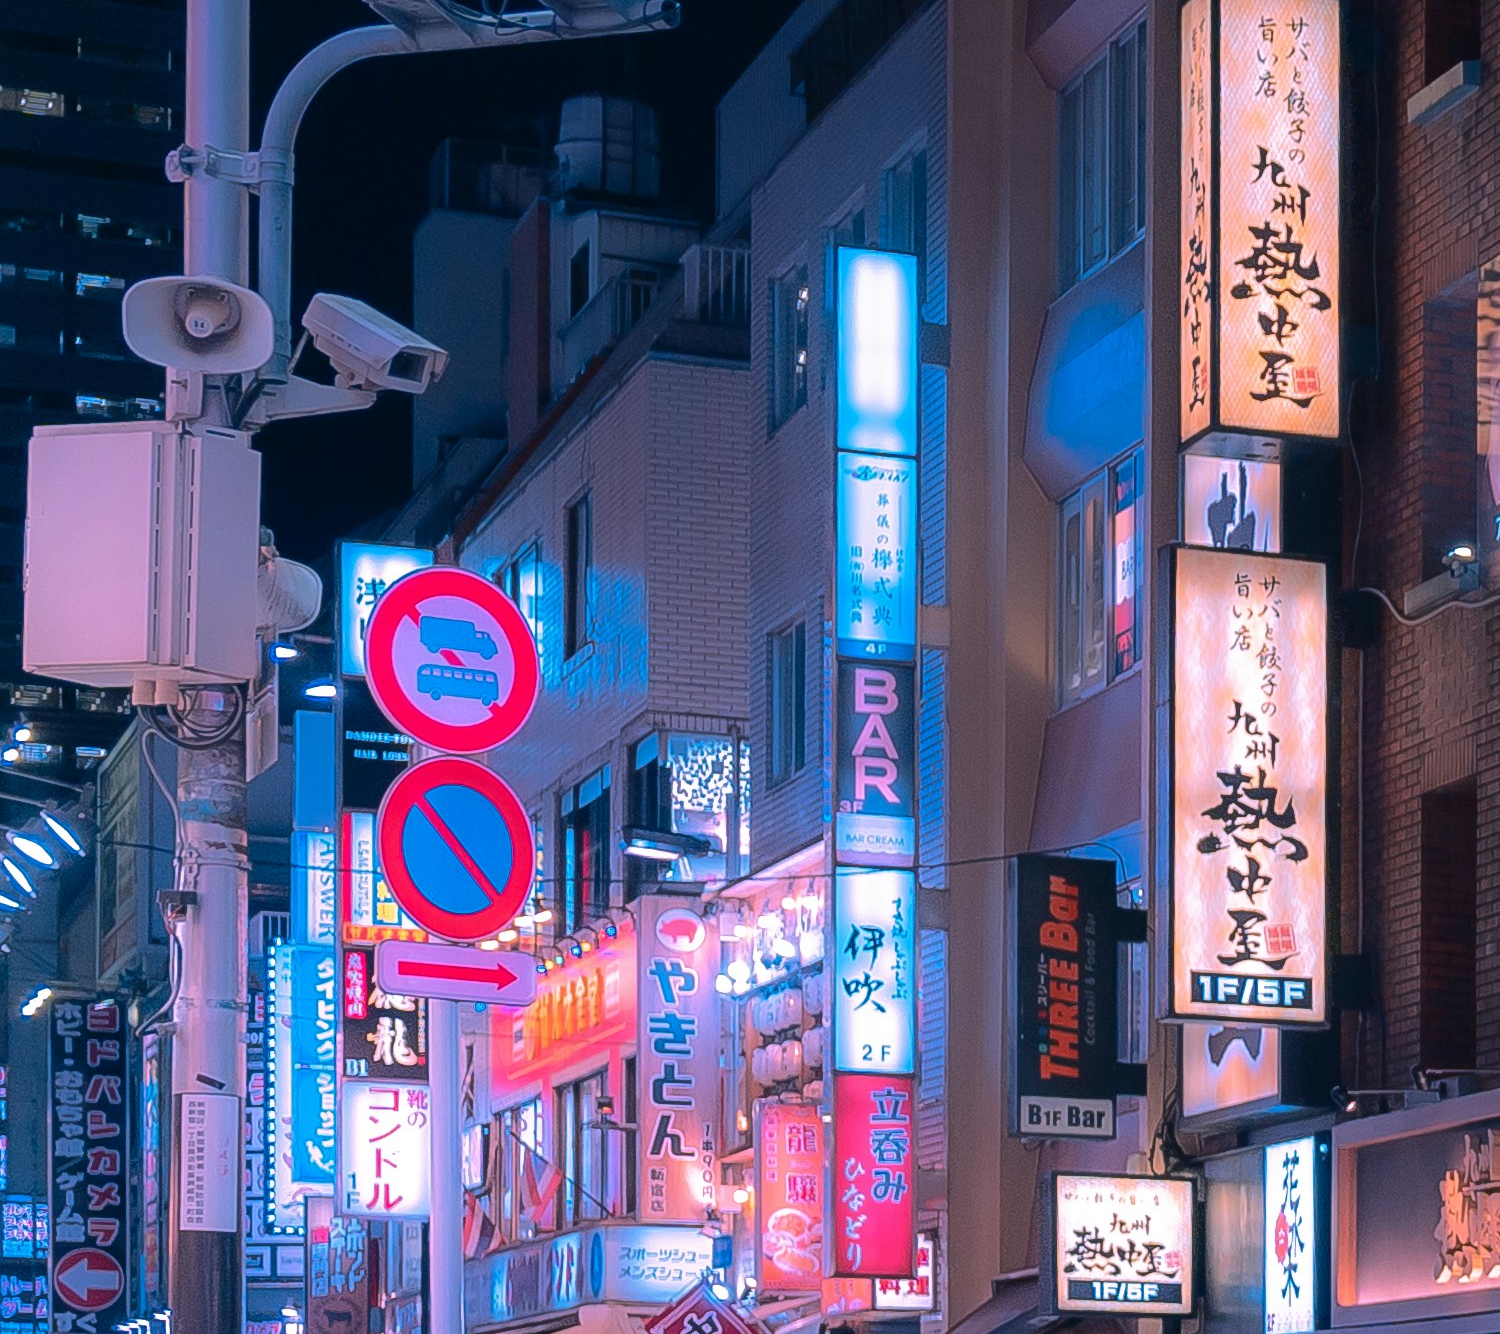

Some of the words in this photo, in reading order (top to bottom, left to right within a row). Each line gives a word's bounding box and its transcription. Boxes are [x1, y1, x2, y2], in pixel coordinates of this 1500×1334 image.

[1255, 16, 1279, 98] 旨い店
[1284, 16, 1311, 165] サバと餃子の
[1230, 145, 1332, 408] 九州熱中屋
[1230, 572, 1253, 652] 旨い店
[1258, 575, 1283, 718] サバと餃子の
[853, 668, 899, 805] BAR
[318, 838, 336, 939] ANSWER
[1197, 700, 1309, 971] 九州熱中屋
[842, 923, 887, 1013] 伊吹
[1040, 958, 1080, 1081] THREE
[1198, 974, 1306, 1007] 1F/5F
[345, 1058, 370, 1077] B1
[648, 957, 700, 1161] やきとん
[861, 1043, 892, 1062] 2F
[85, 1002, 122, 1247] ヨドバシカメラ
[365, 1085, 404, 1213] コンドル
[406, 1088, 429, 1128] 靴の
[869, 1086, 909, 1204] 立呑み
[1028, 1103, 1062, 1127] B1F
[1067, 1104, 1106, 1129] Bar
[842, 1156, 868, 1272] ひなどり
[1063, 1225, 1180, 1279] 熱中屋
[1110, 1212, 1152, 1236] 九州
[1279, 1150, 1305, 1307] 花水木
[53, 1312, 99, 1334] すぐ
